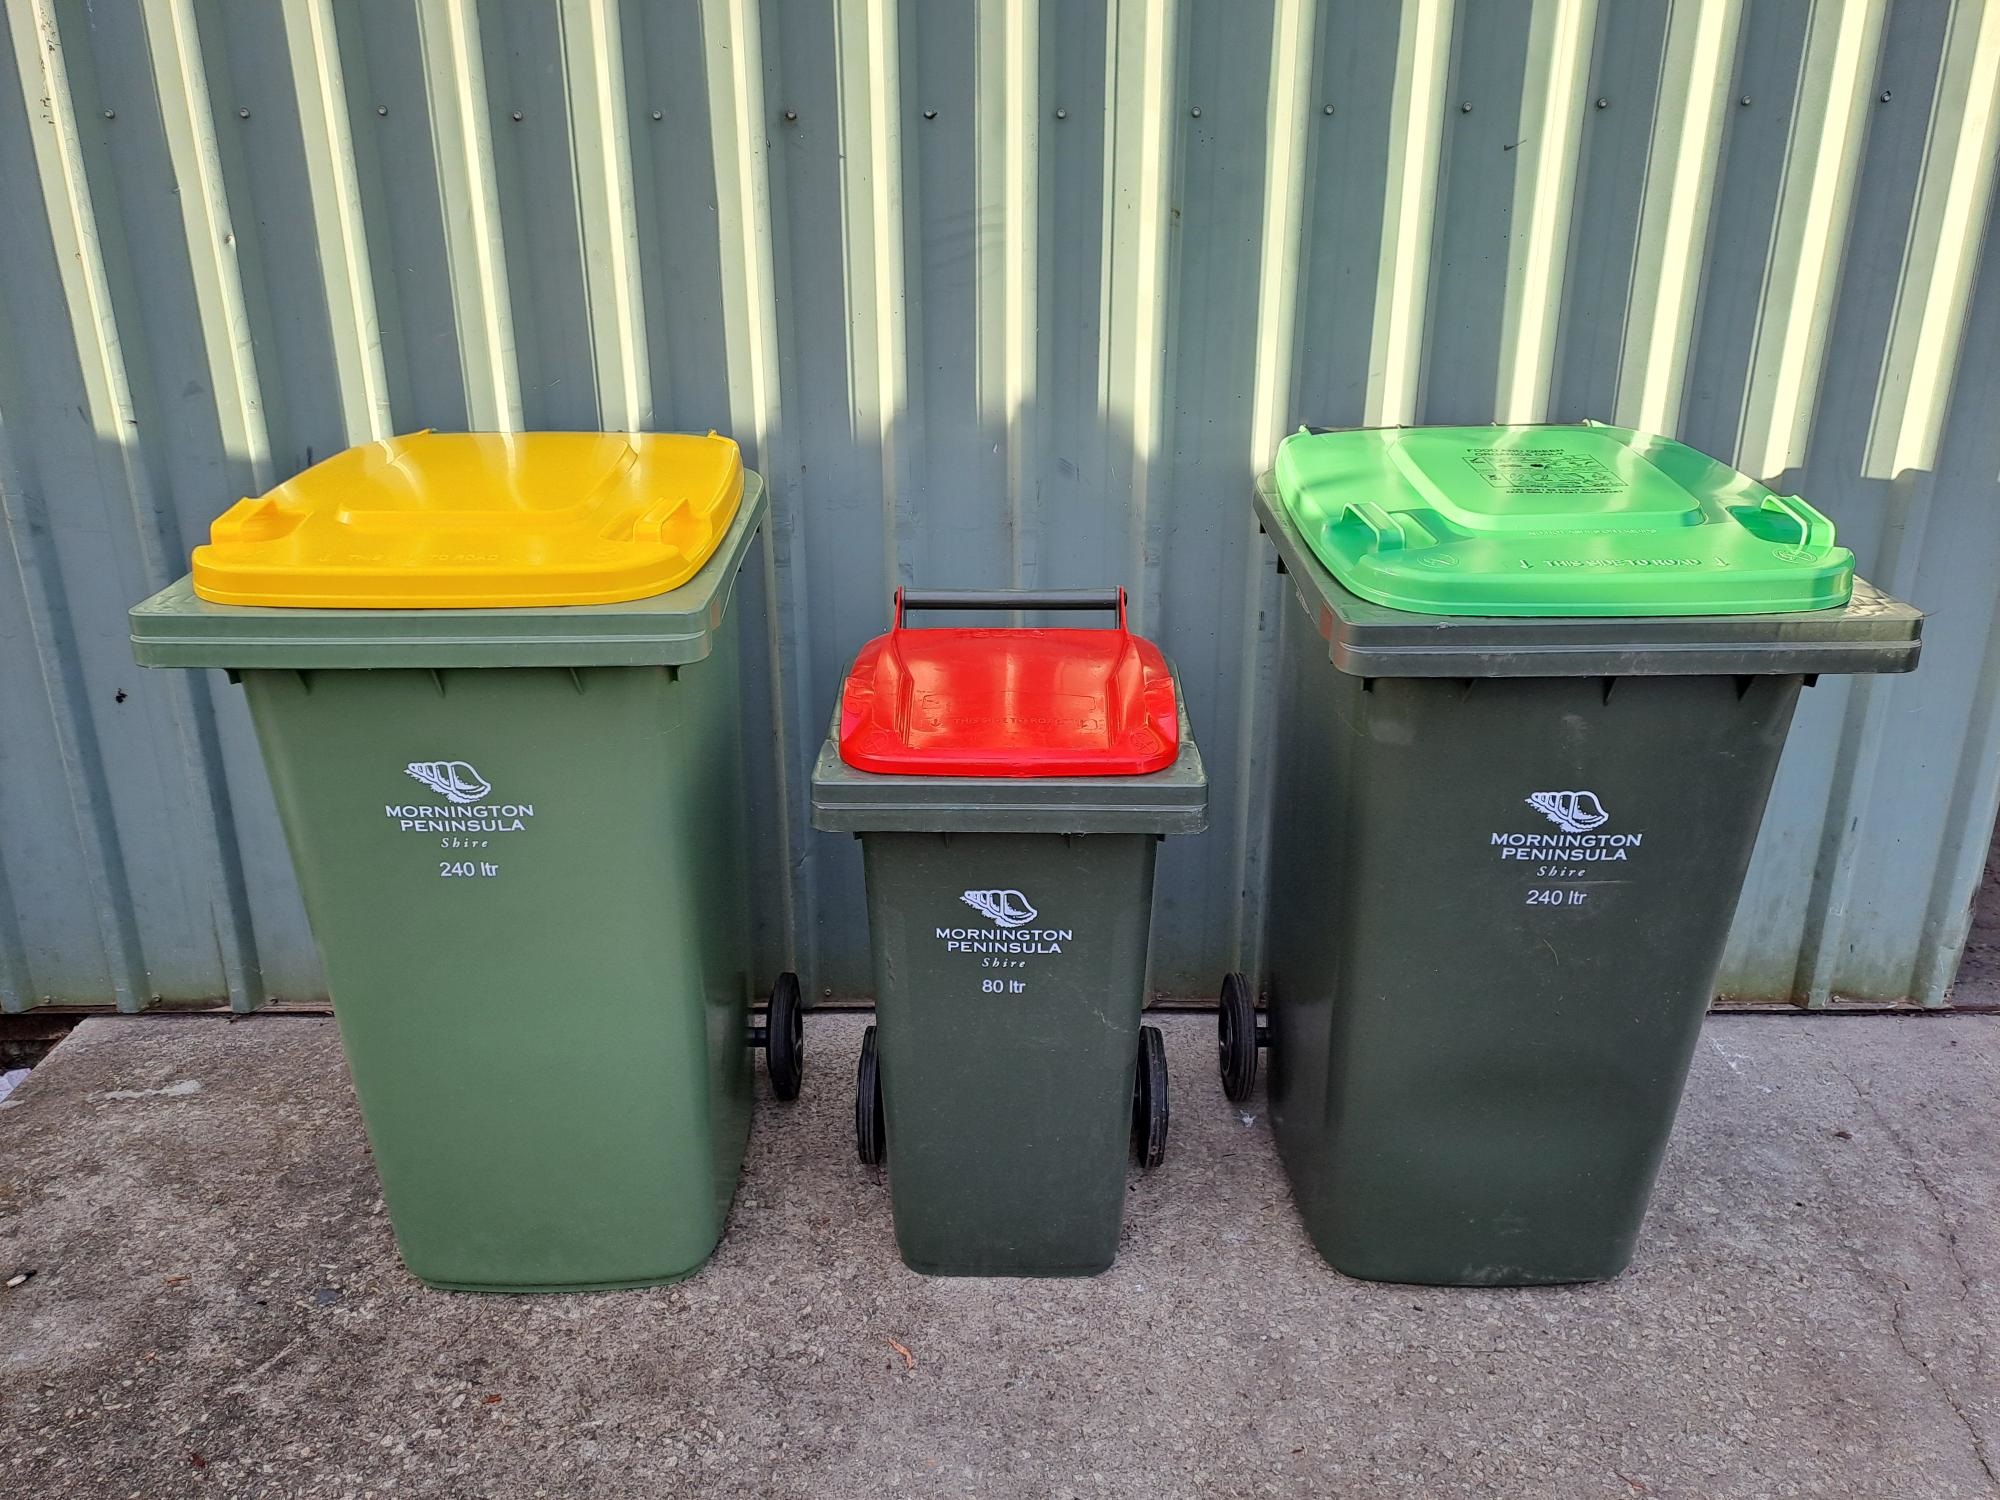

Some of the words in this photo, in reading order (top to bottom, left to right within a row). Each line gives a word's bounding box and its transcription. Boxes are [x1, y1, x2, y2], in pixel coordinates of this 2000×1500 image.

[1543, 559, 1584, 567] THIS
[1653, 559, 1702, 567] ROAD
[385, 804, 534, 817] MORNINGTON
[400, 819, 526, 832] PENINSULA
[440, 837, 488, 848] Shire
[1490, 833, 1643, 847] MORNINGTON
[1501, 847, 1628, 861] PENINSULA
[439, 862, 475, 877] 240
[480, 862, 499, 877] ltr
[1536, 866, 1586, 877] Shire
[1526, 890, 1563, 905] 240
[1568, 890, 1588, 905] ltr
[935, 928, 1072, 941] MORNINGTON
[947, 941, 1062, 954] PENINSULA
[981, 958, 1026, 968] Shire
[982, 979, 1004, 993] 80
[1009, 979, 1026, 993] ltr
